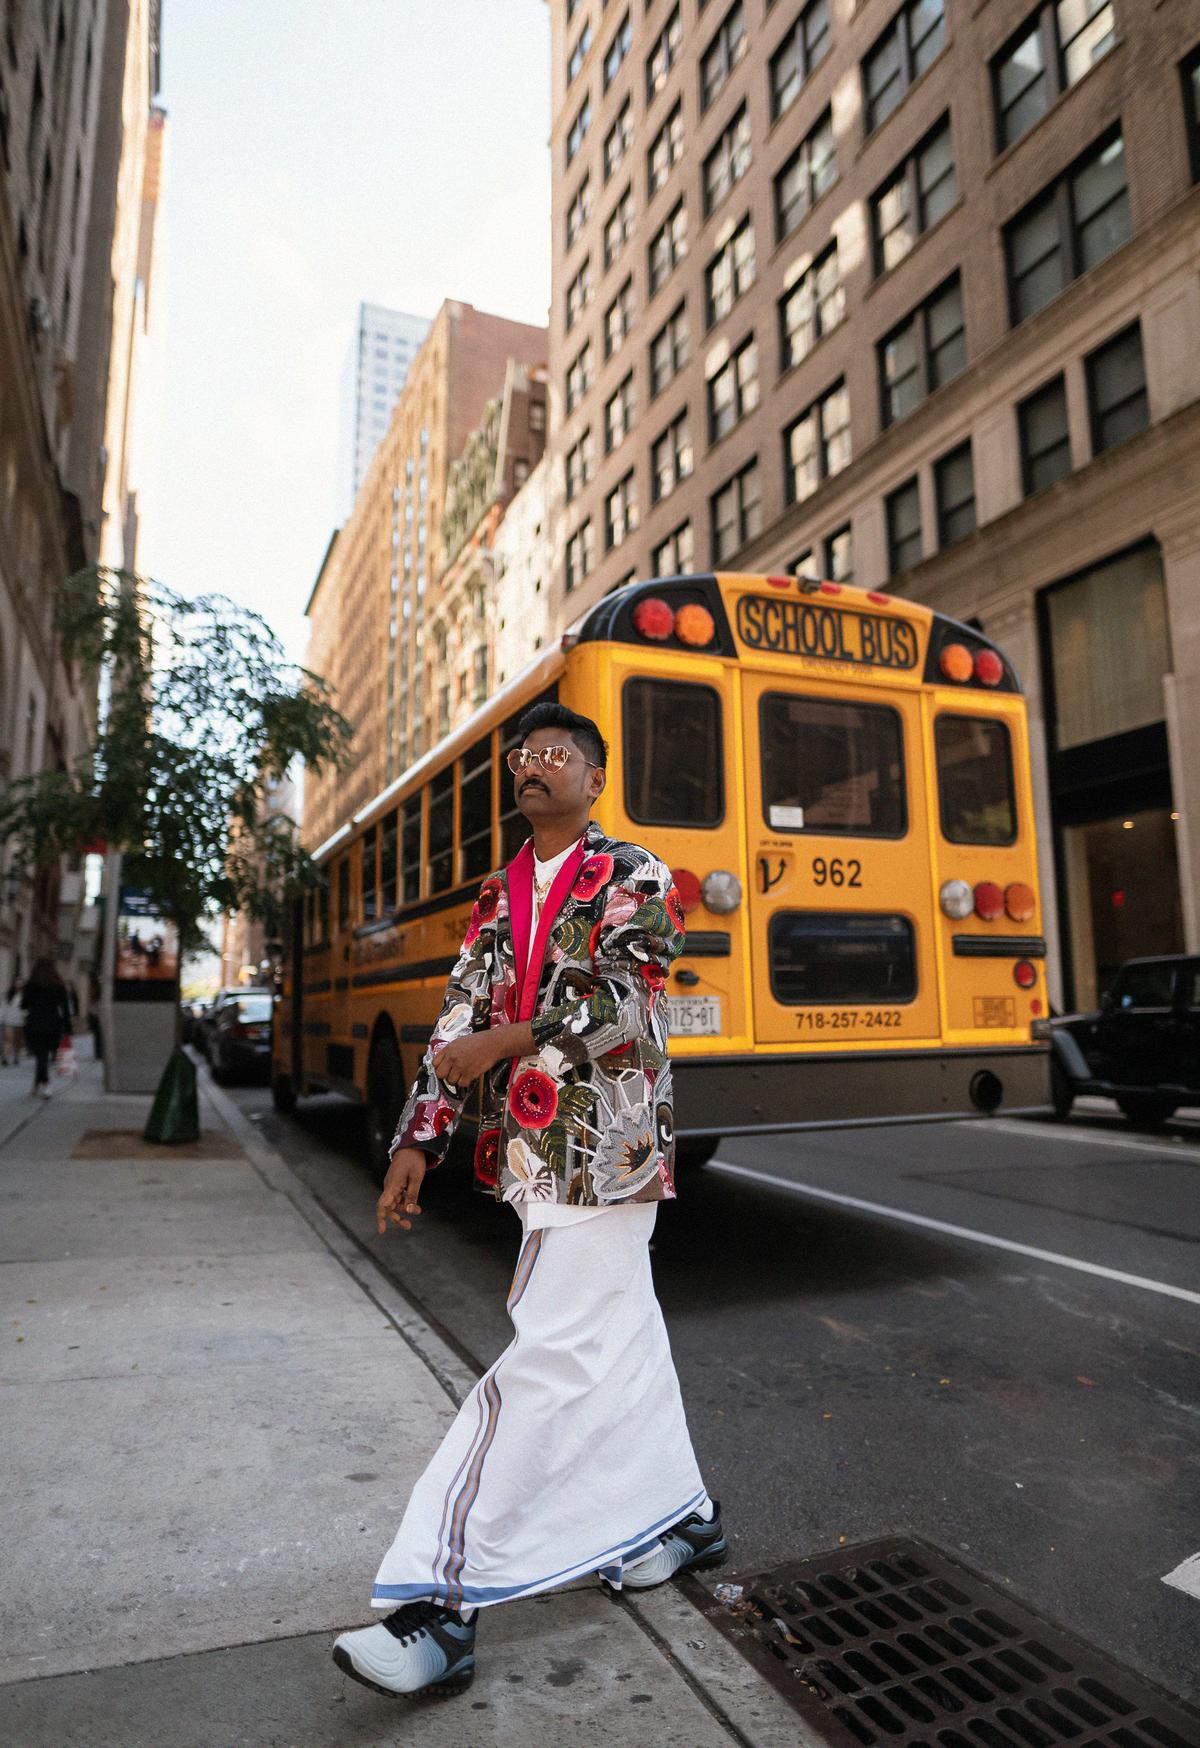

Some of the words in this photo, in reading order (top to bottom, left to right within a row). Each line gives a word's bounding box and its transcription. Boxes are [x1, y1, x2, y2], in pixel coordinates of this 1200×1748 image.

[744, 599, 854, 658] SCHOOL
[858, 615, 911, 667] BUS
[812, 857, 862, 888] 962
[795, 1011, 902, 1029] 718-257-2422
